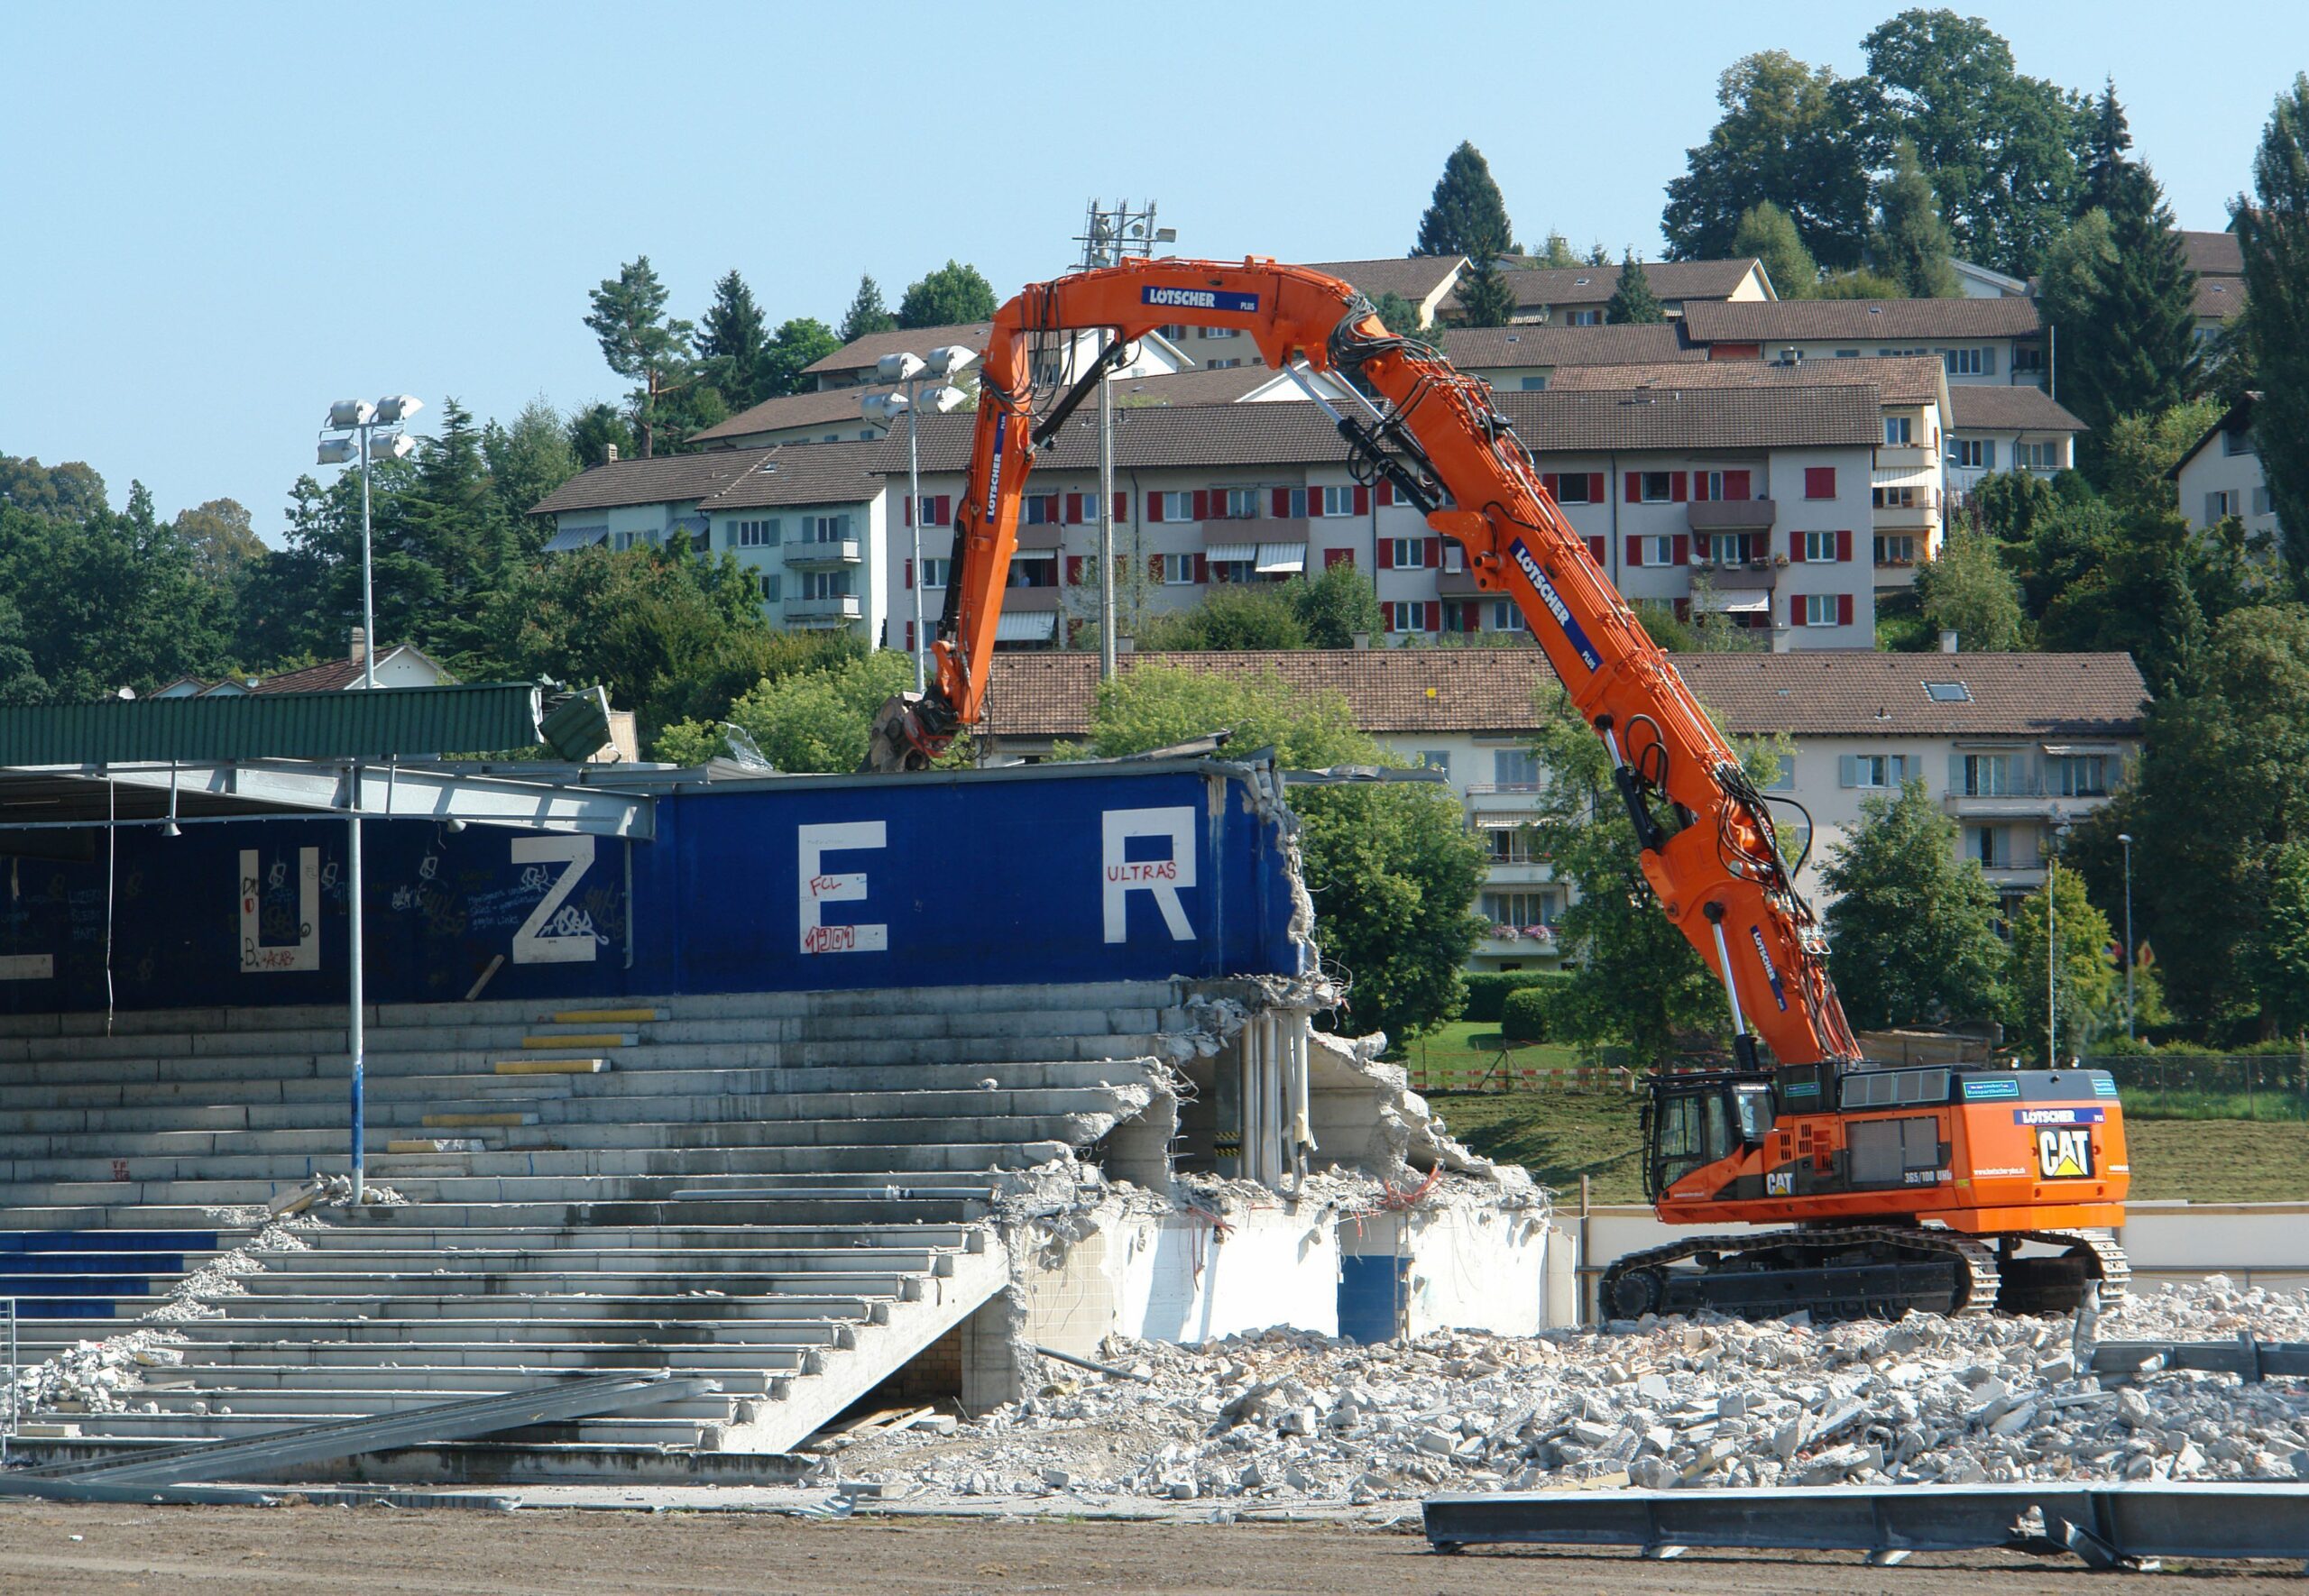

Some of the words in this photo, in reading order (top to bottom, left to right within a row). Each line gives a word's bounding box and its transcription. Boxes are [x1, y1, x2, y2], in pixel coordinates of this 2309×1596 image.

[1240, 302, 1255, 310] PLUS
[1581, 650, 1596, 670] PLUS
[1108, 862, 1176, 882] ULTRAS
[810, 876, 842, 896] FCL
[805, 925, 855, 954] 1901
[2039, 1130, 2090, 1177] CAT
[1766, 1172, 1793, 1195] CAT
